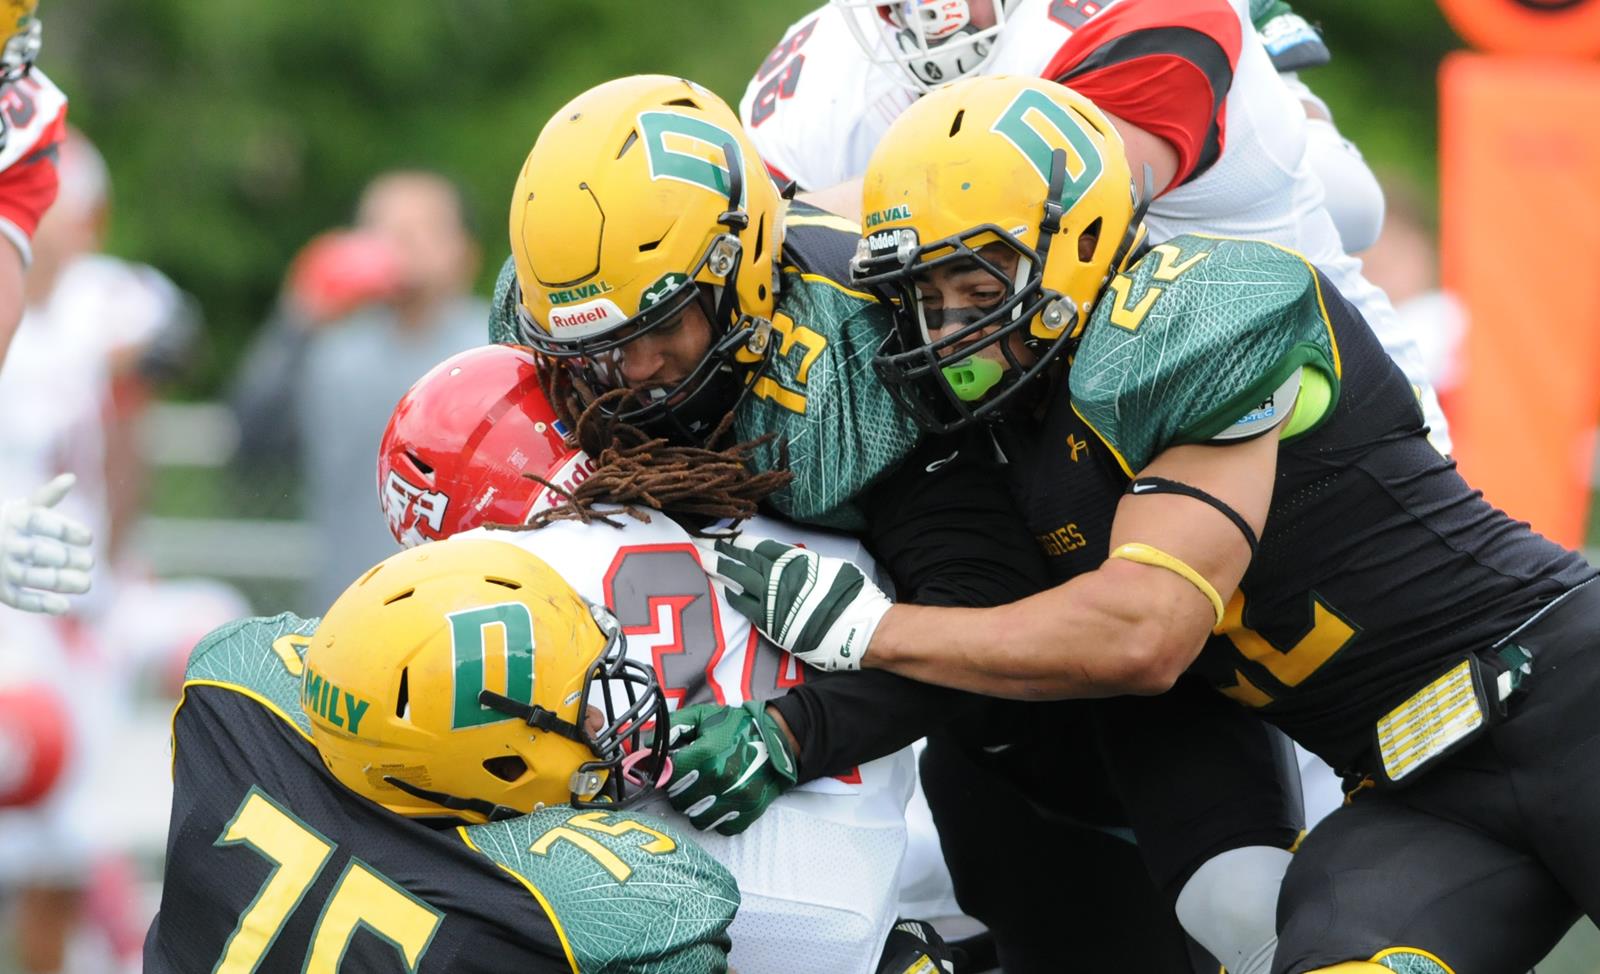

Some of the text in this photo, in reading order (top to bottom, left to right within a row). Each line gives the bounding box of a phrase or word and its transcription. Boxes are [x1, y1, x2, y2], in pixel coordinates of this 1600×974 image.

[637, 110, 748, 209] D
[989, 87, 1104, 216] D
[865, 204, 912, 229] DELVAL
[547, 280, 614, 305] DELVAL
[552, 306, 608, 328] Riddell
[1109, 243, 1211, 333] 22
[750, 308, 828, 417] 13
[444, 600, 536, 732] D
[528, 810, 678, 886] 75
